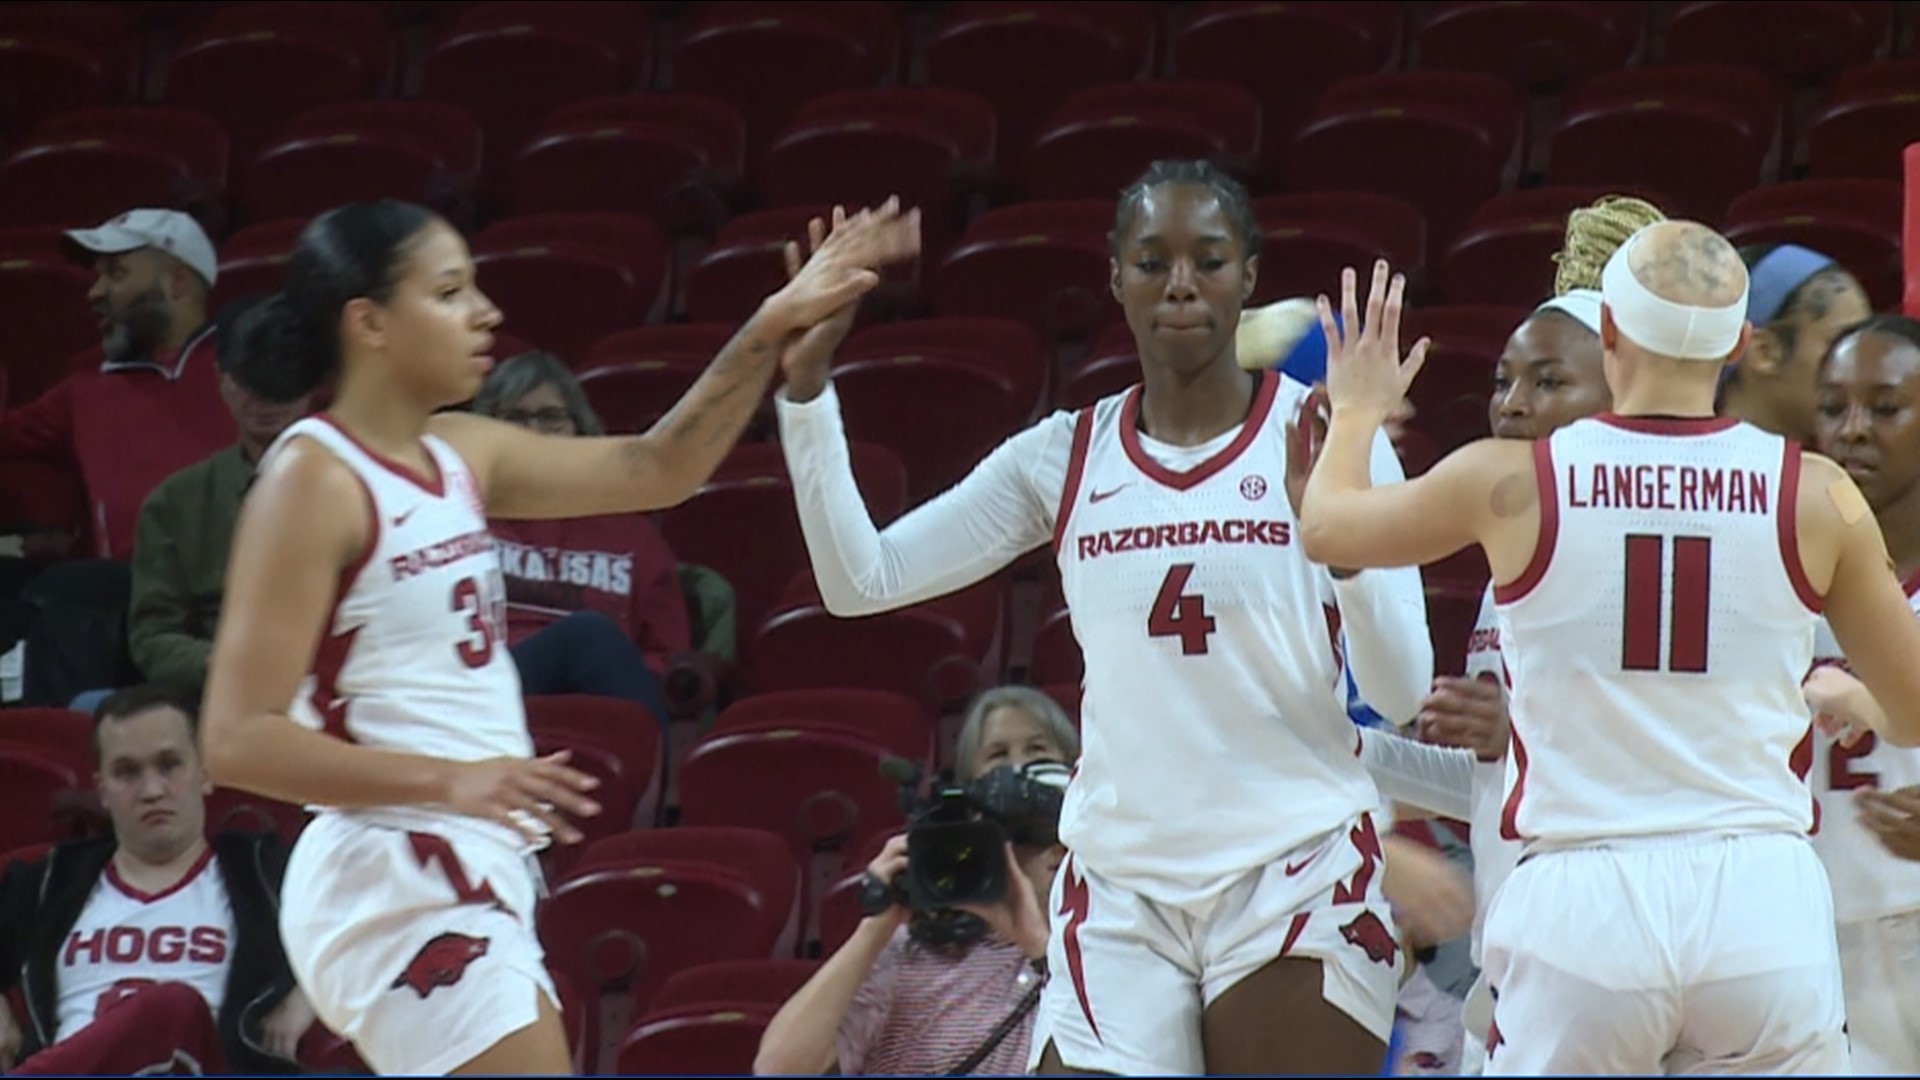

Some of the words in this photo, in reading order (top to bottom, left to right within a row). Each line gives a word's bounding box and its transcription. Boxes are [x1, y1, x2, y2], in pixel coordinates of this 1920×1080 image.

[1568, 464, 1768, 515] LANGERMAN
[1078, 520, 1291, 561] RAZORBACKS
[1148, 562, 1216, 656] 4
[1621, 533, 1711, 673] 11
[64, 925, 227, 967] HOGS
